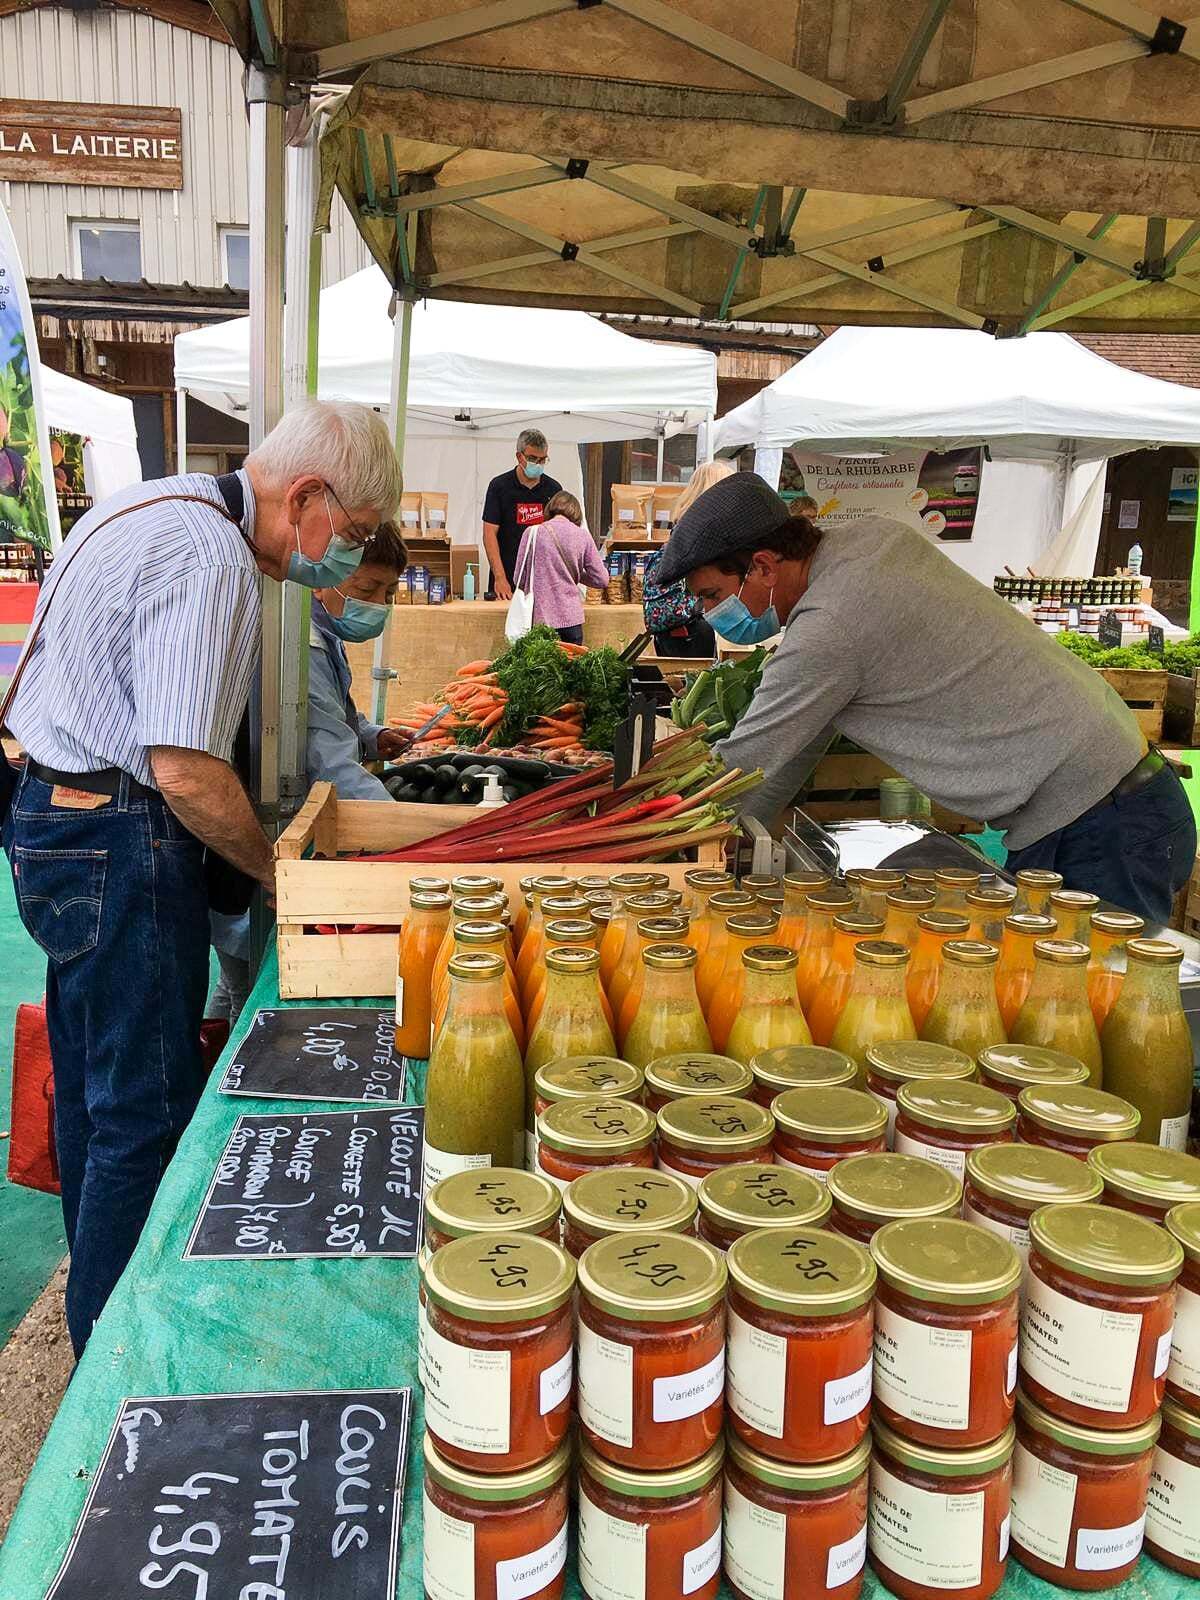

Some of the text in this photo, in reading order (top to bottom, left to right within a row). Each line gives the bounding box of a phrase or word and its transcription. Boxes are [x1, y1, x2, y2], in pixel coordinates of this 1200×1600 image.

[0, 130, 178, 160] LA LAITERIE
[806, 462, 916, 477] DE LA RHUBARBE
[285, 1128, 332, 1184] COURGE
[383, 1111, 421, 1200] VELOUTÉ
[1026, 1315, 1059, 1346] TOMATES
[1051, 1318, 1066, 1333] DE
[666, 1382, 706, 1402] Variétés
[873, 1503, 909, 1533] TOMATES
[899, 1505, 914, 1521] DE
[1086, 1543, 1124, 1555] Variétés
[511, 1559, 549, 1583] Variétés
